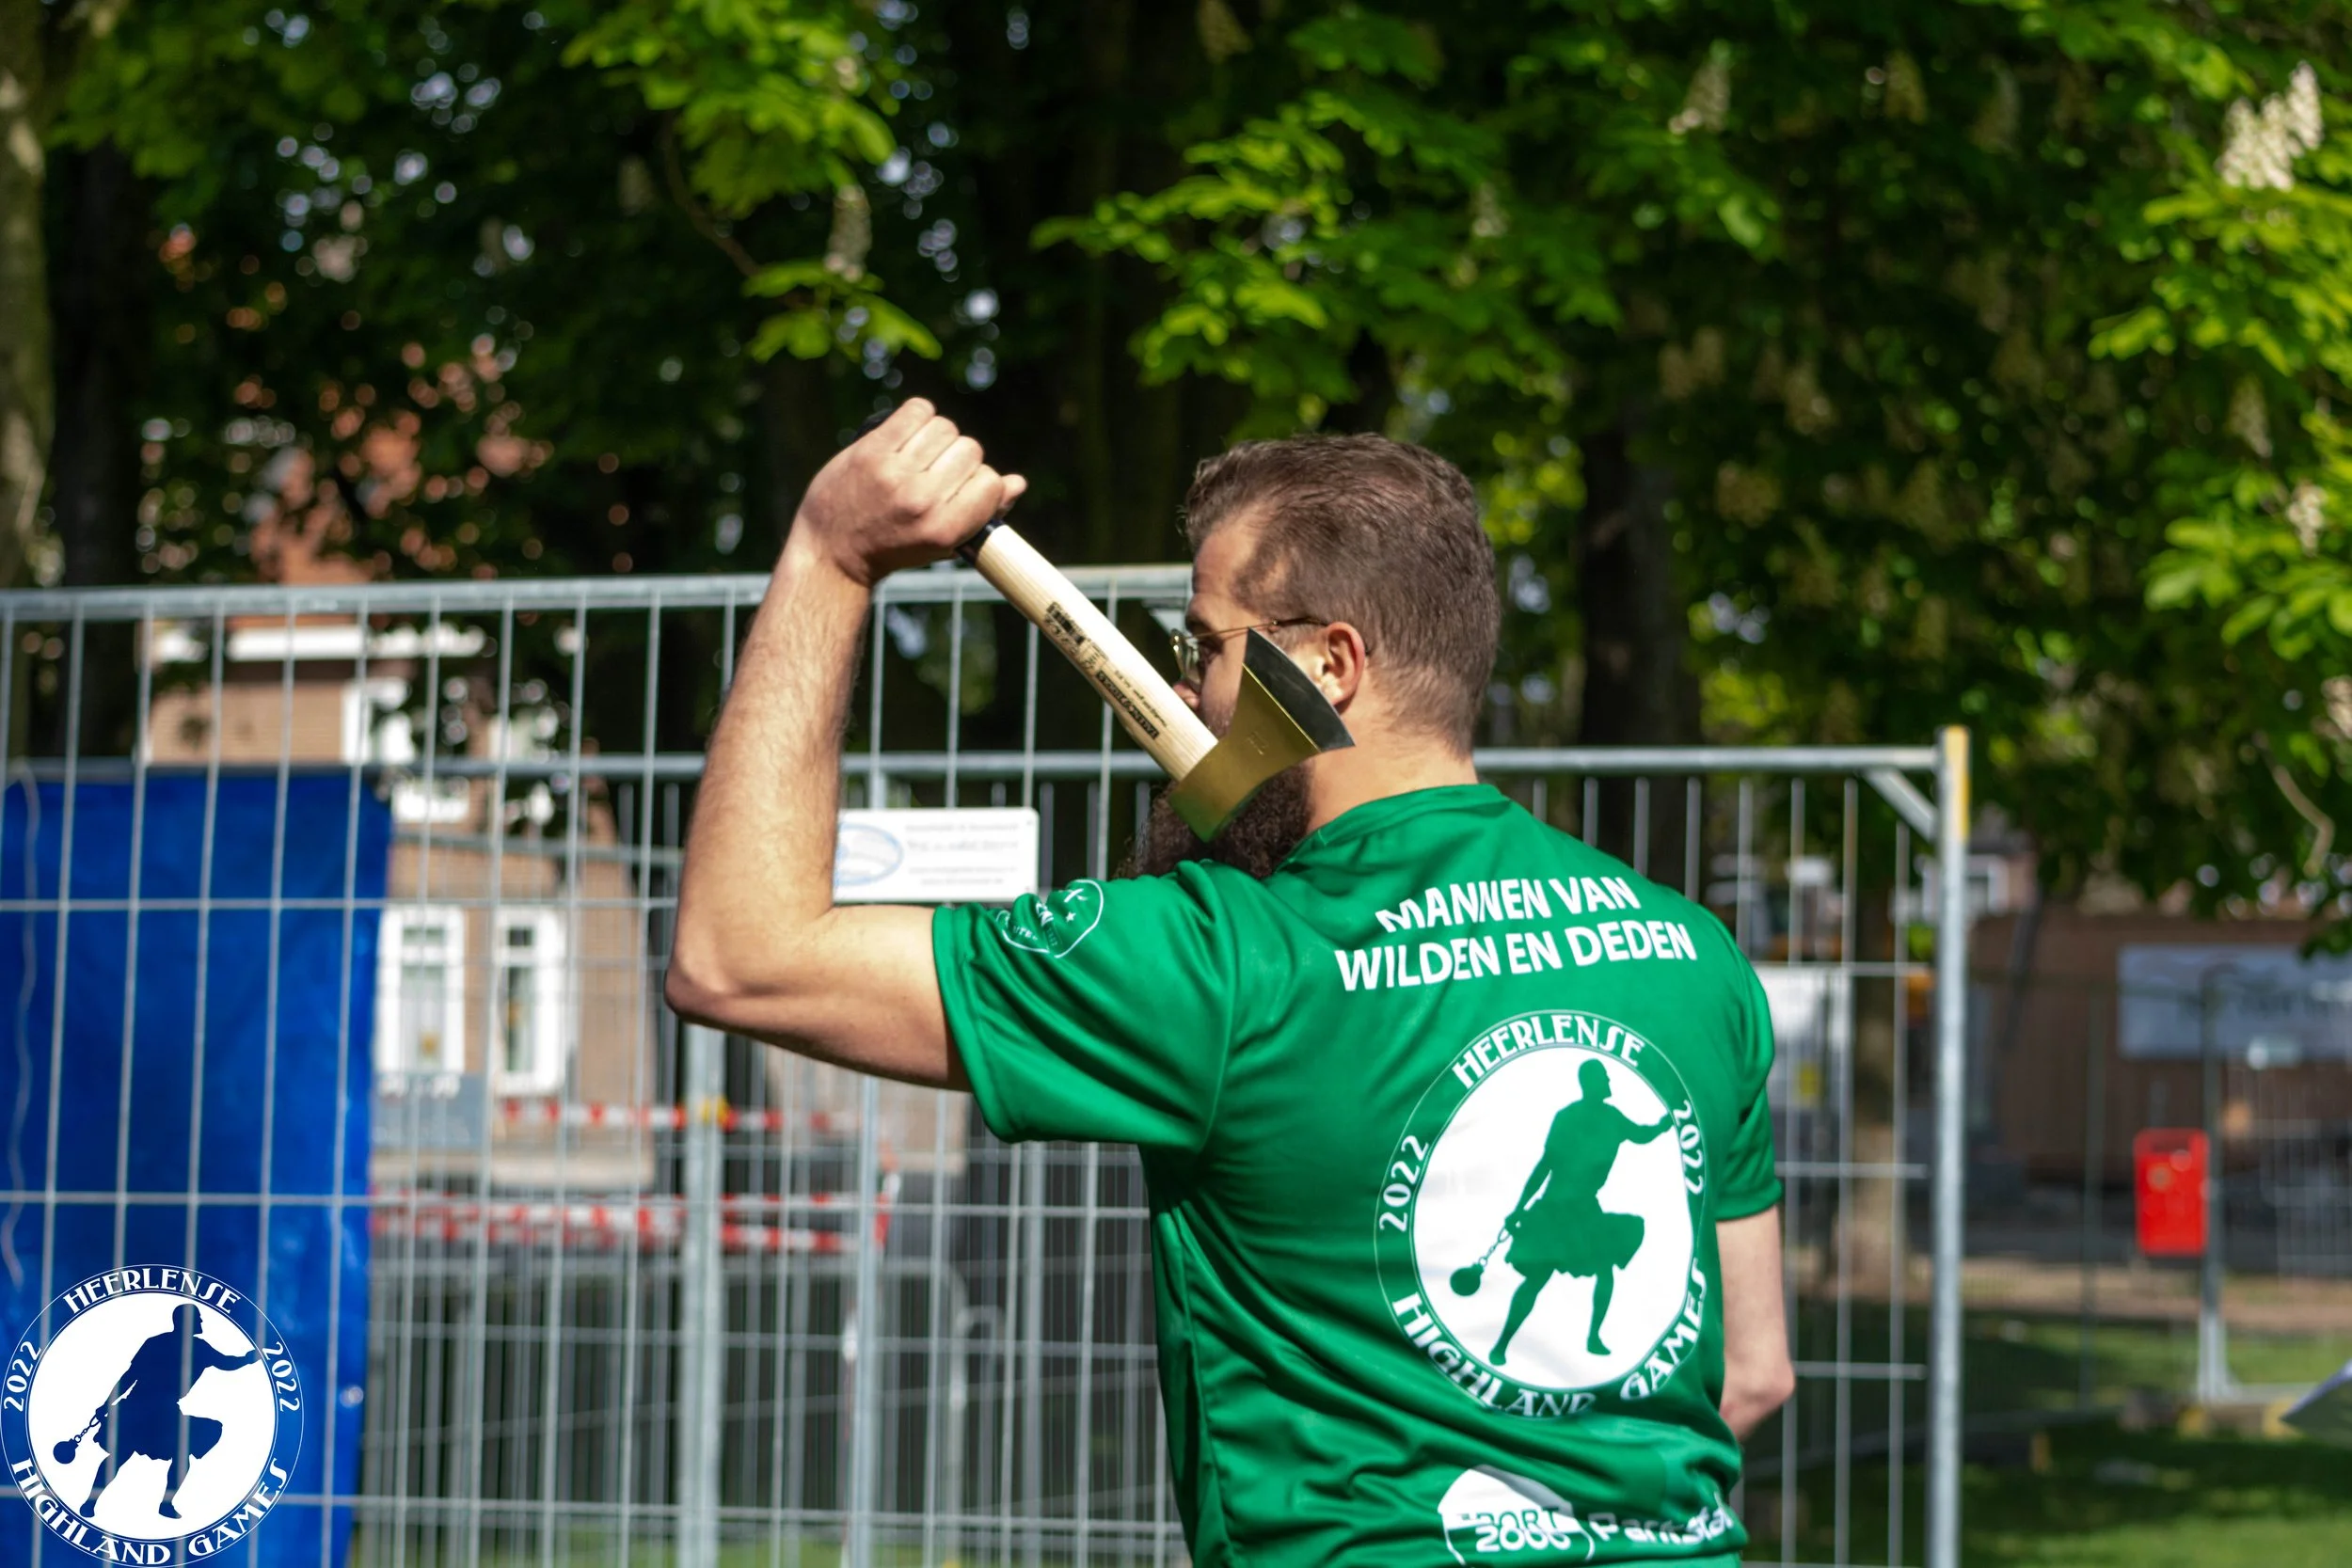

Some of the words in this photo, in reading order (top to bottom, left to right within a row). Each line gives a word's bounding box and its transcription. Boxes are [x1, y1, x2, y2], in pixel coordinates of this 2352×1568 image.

[1375, 879, 1552, 933] MANNEN
[1549, 877, 1642, 914] VAN
[1334, 937, 1501, 991] WILDEN
[1506, 931, 1563, 974] EN
[1564, 920, 1697, 967] DEDEN
[1451, 1014, 1645, 1089] HEERLENSE
[1378, 1135, 1430, 1232] 2022
[1671, 1100, 1705, 1196] 2022
[1391, 1291, 1597, 1418] HIGHLAND
[1619, 1258, 1708, 1401] GAMES
[1474, 1524, 1571, 1552] 2000
